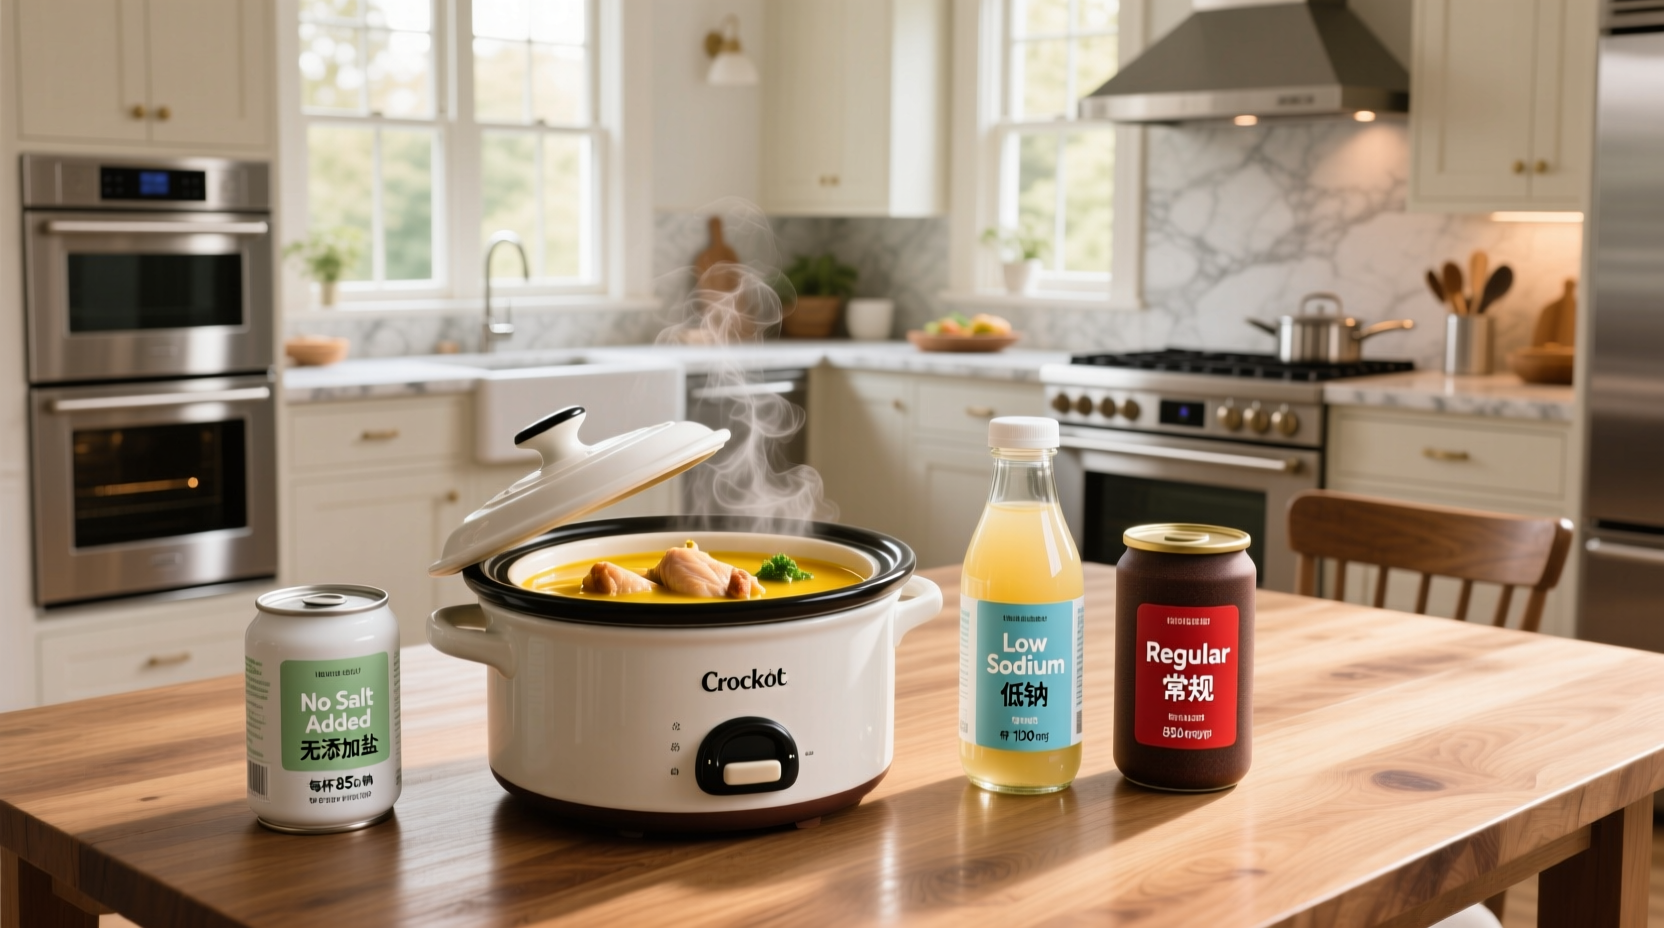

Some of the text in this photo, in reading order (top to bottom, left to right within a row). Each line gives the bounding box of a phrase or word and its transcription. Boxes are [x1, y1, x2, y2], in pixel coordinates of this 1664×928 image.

[1003, 632, 1048, 653] Low
[1146, 640, 1231, 671] Regular
[986, 653, 1065, 675] Sodium
[301, 686, 374, 712] No Salt
[1000, 681, 1048, 708] 低钠
[1162, 673, 1214, 702] 常规
[305, 708, 371, 734] Added
[300, 733, 379, 761] 无添加盐
